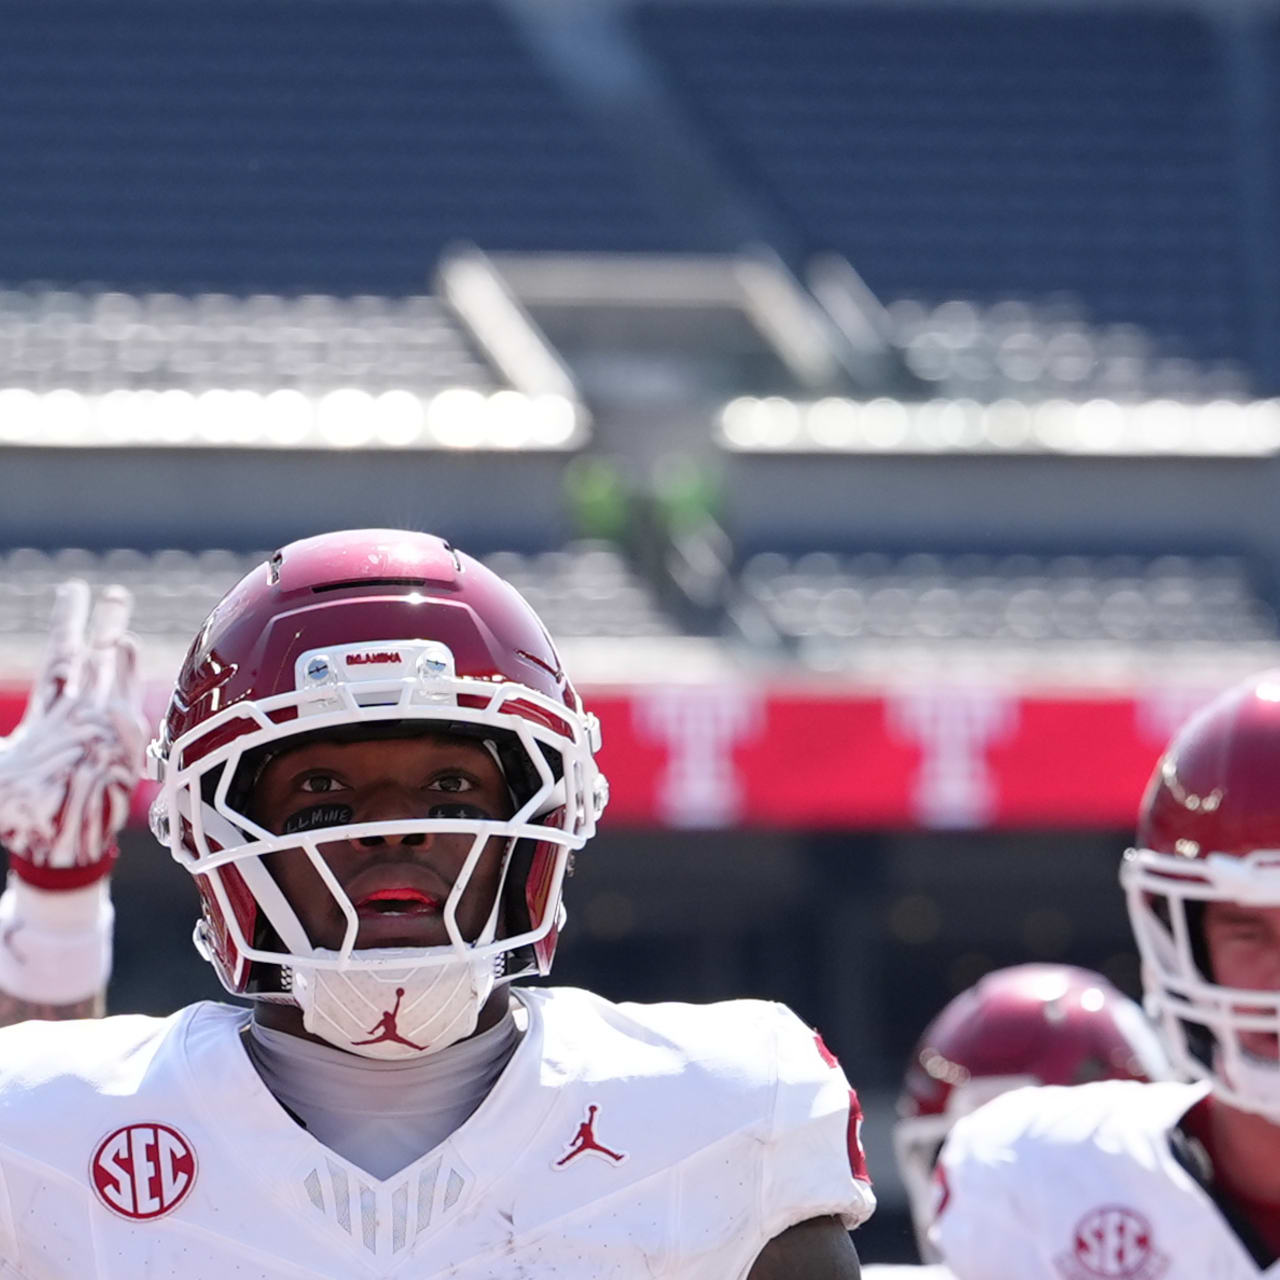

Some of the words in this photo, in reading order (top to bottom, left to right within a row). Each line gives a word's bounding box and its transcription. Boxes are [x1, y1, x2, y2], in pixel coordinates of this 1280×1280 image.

[629, 687, 766, 827] T
[883, 687, 1020, 827] T
[98, 1127, 189, 1213] SEC
[1078, 1211, 1147, 1274] SEC
